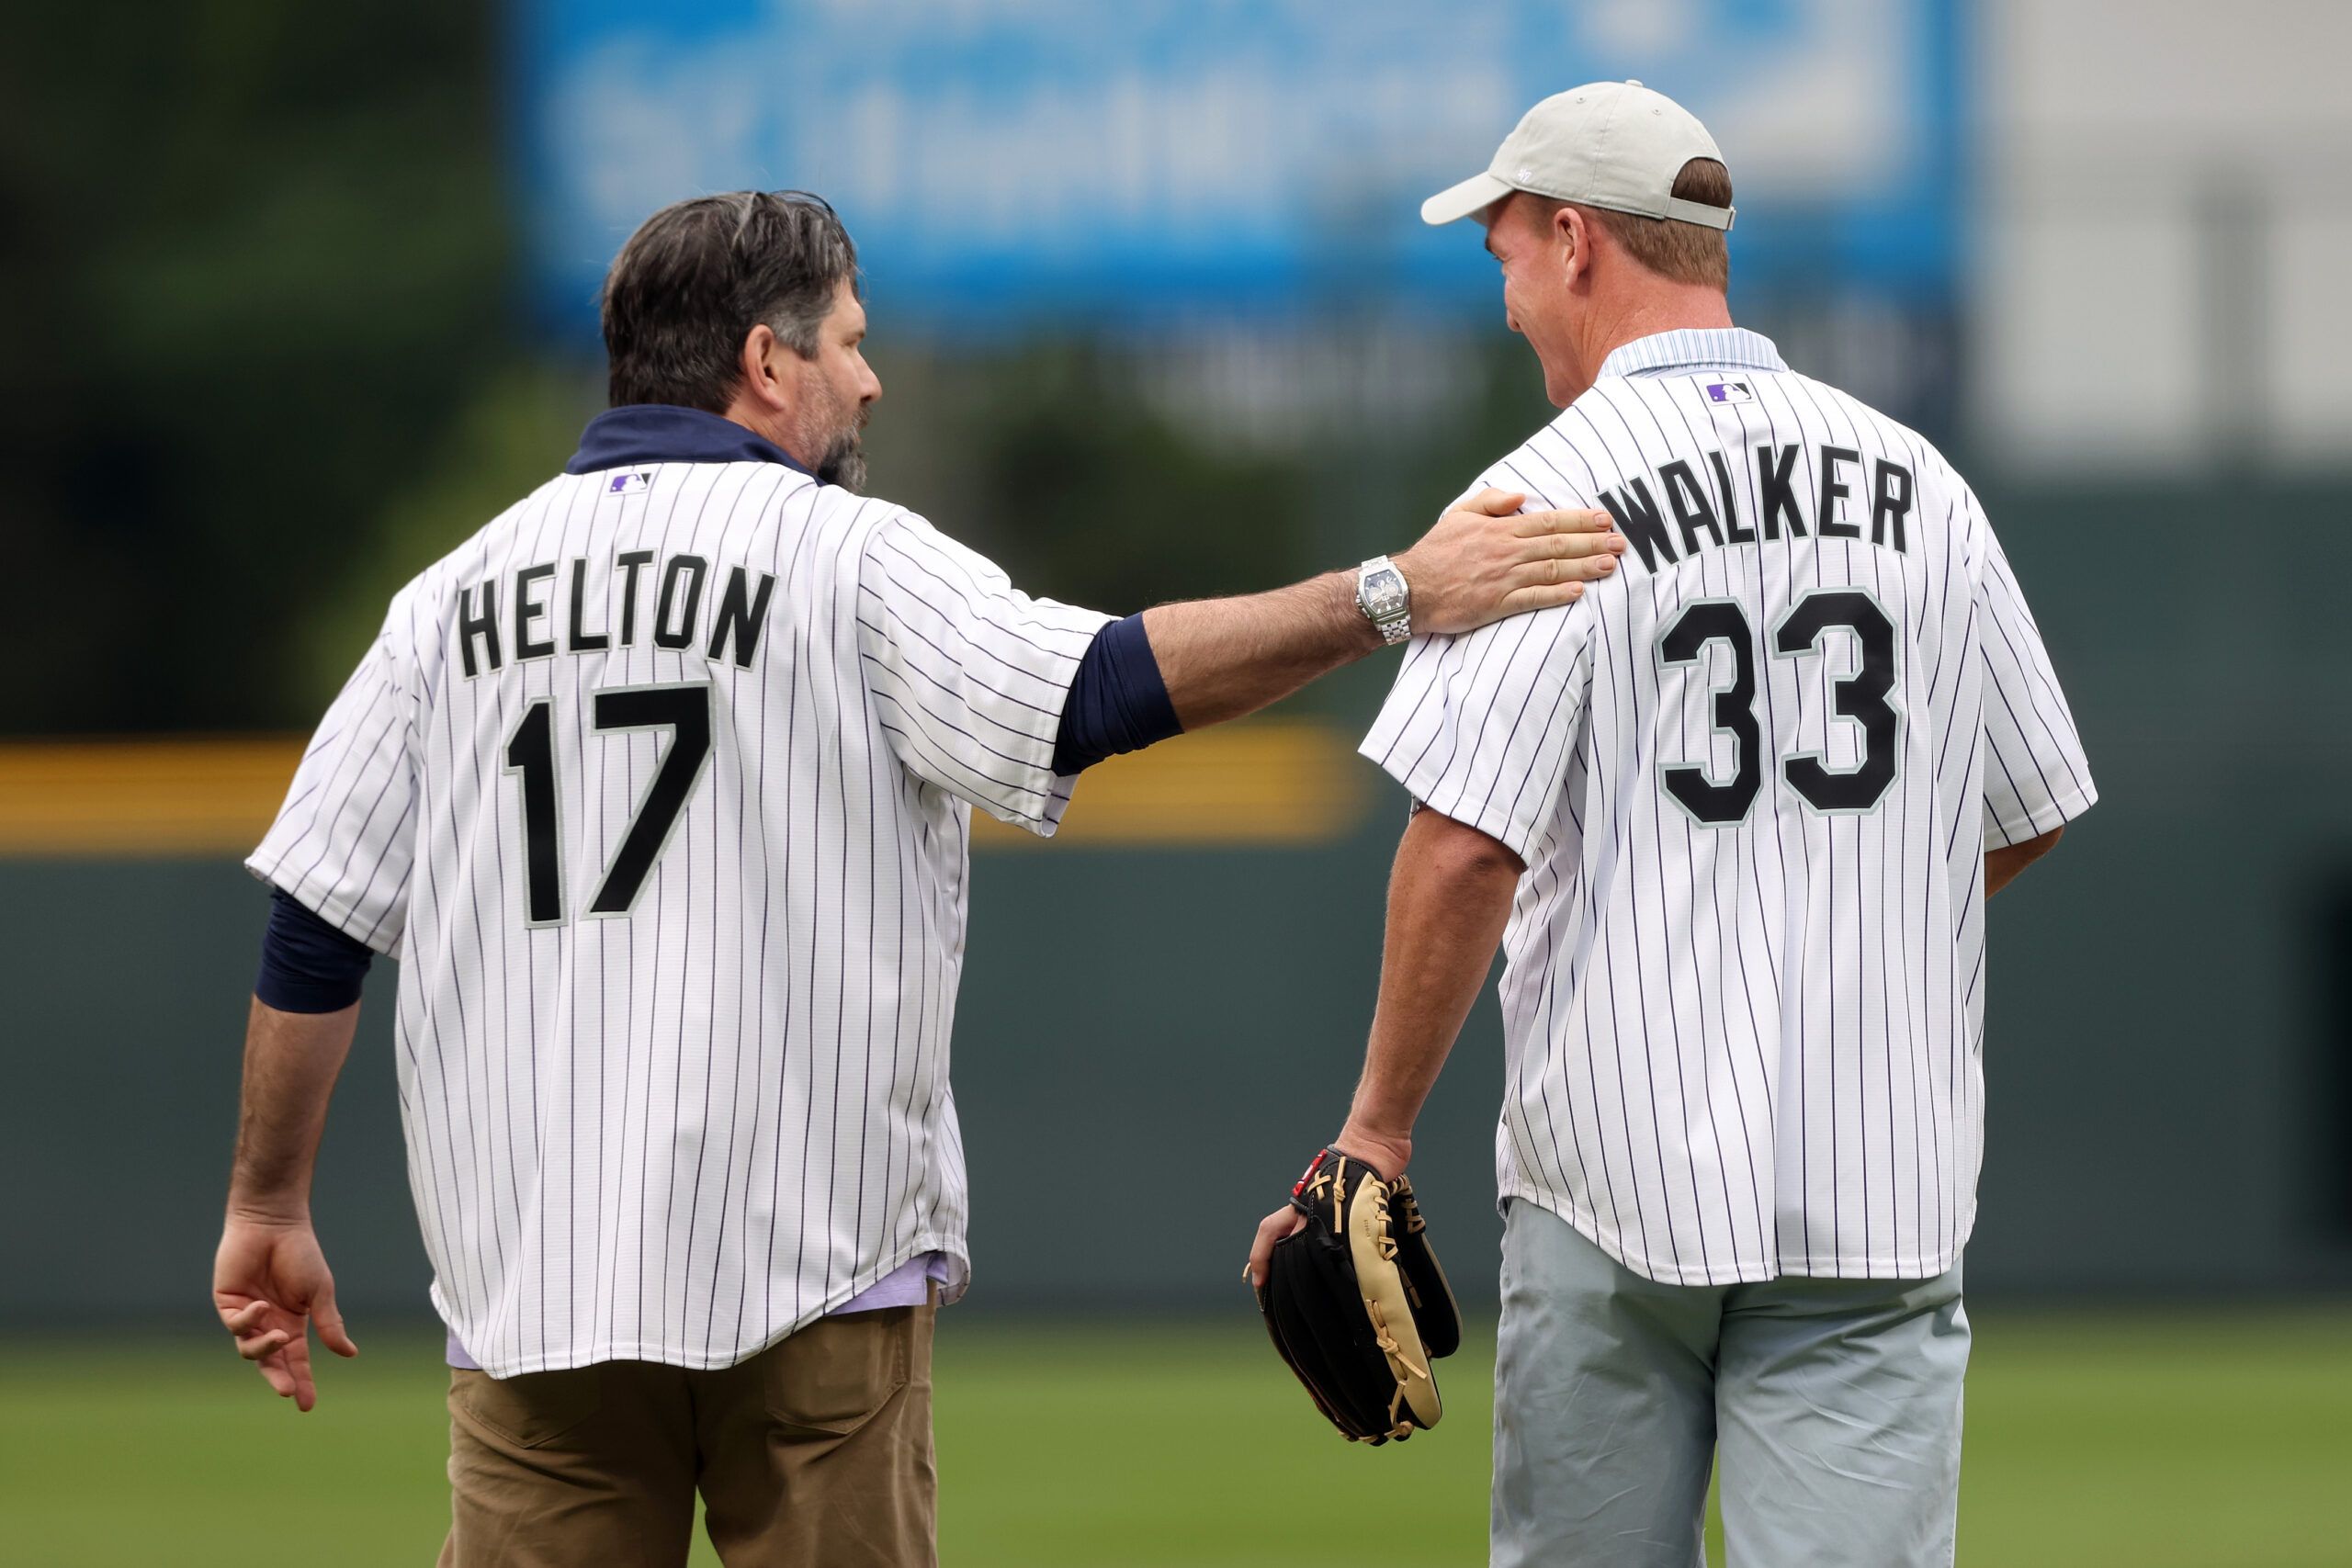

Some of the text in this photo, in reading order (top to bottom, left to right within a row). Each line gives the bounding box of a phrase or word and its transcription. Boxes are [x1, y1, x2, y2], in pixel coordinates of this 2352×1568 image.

[1596, 443, 1913, 575] WALKER
[459, 548, 778, 681] HELTON
[1656, 586, 1903, 829] 33
[503, 681, 718, 929] 17
